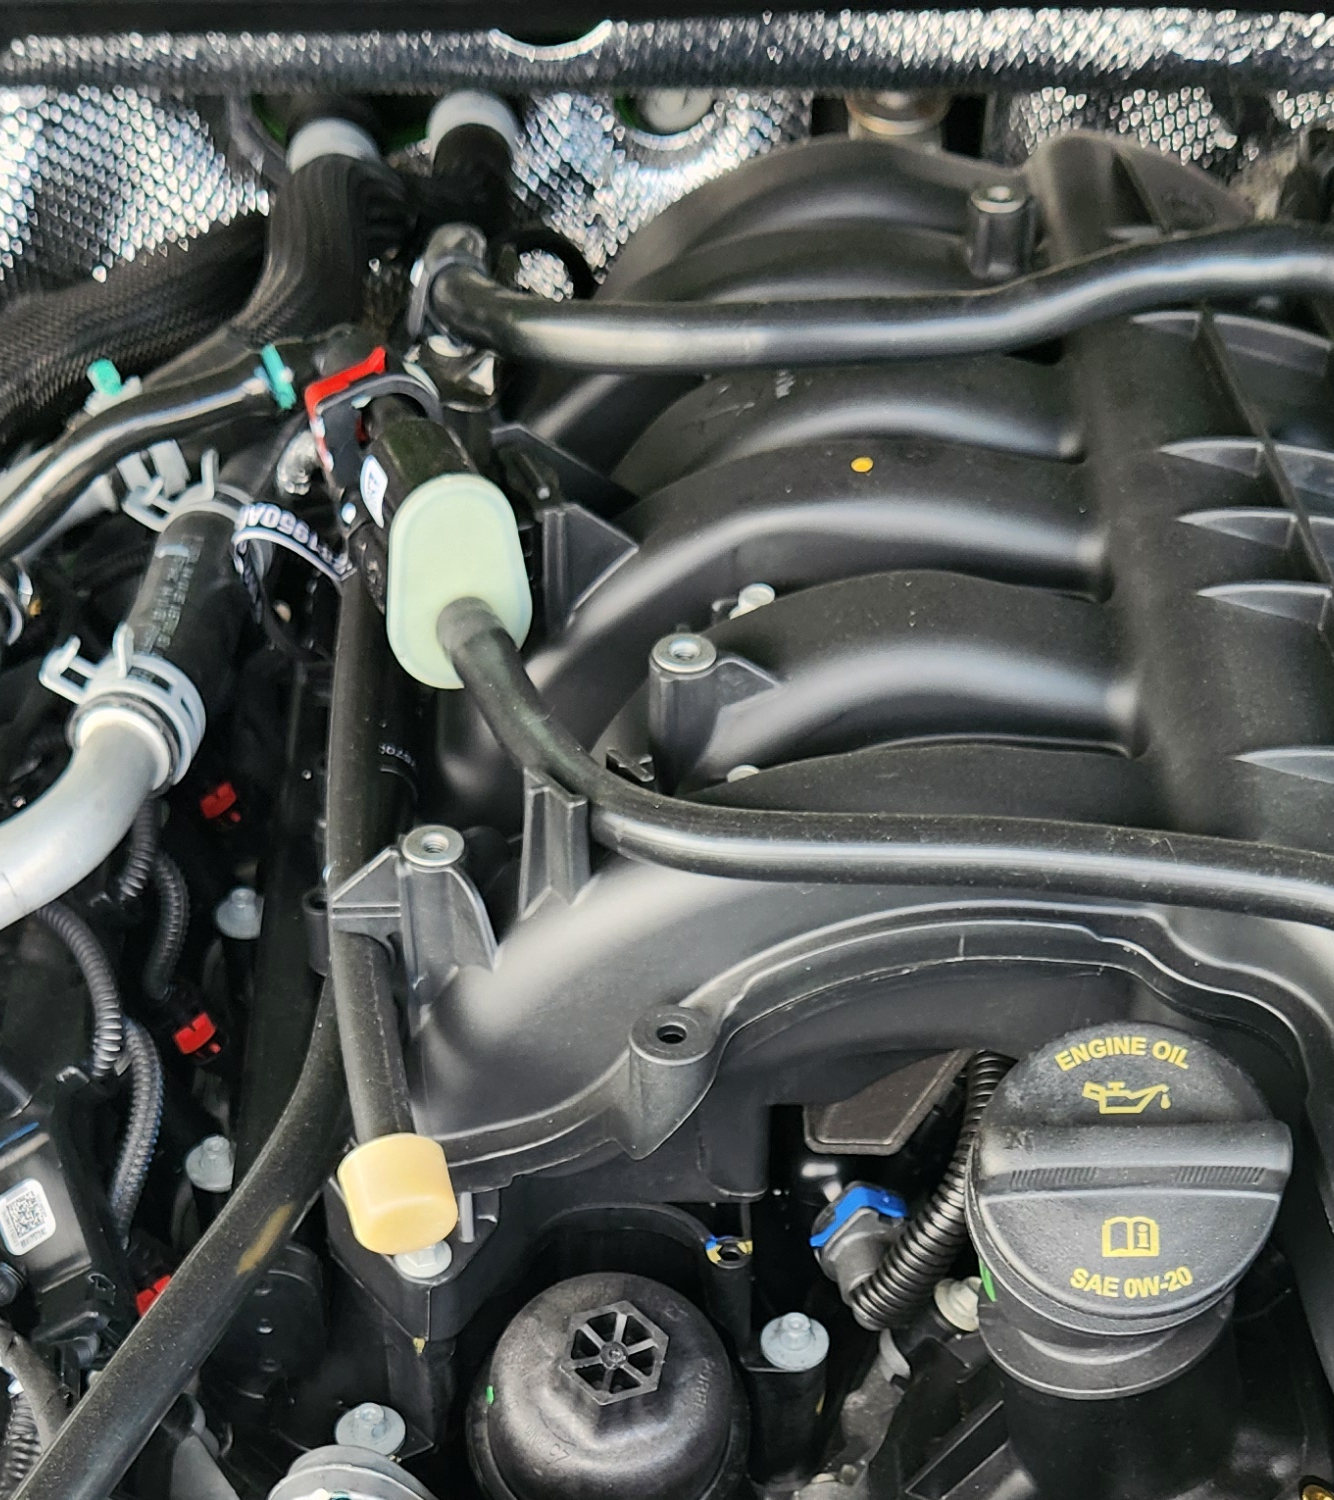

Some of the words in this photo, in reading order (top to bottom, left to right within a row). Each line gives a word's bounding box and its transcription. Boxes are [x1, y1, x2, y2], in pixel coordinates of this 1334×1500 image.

[1055, 1036, 1148, 1071] ENGINE
[1152, 1041, 1189, 1069] OIL
[1070, 1268, 1119, 1297] SAE
[1124, 1266, 1193, 1299] 0W-20
